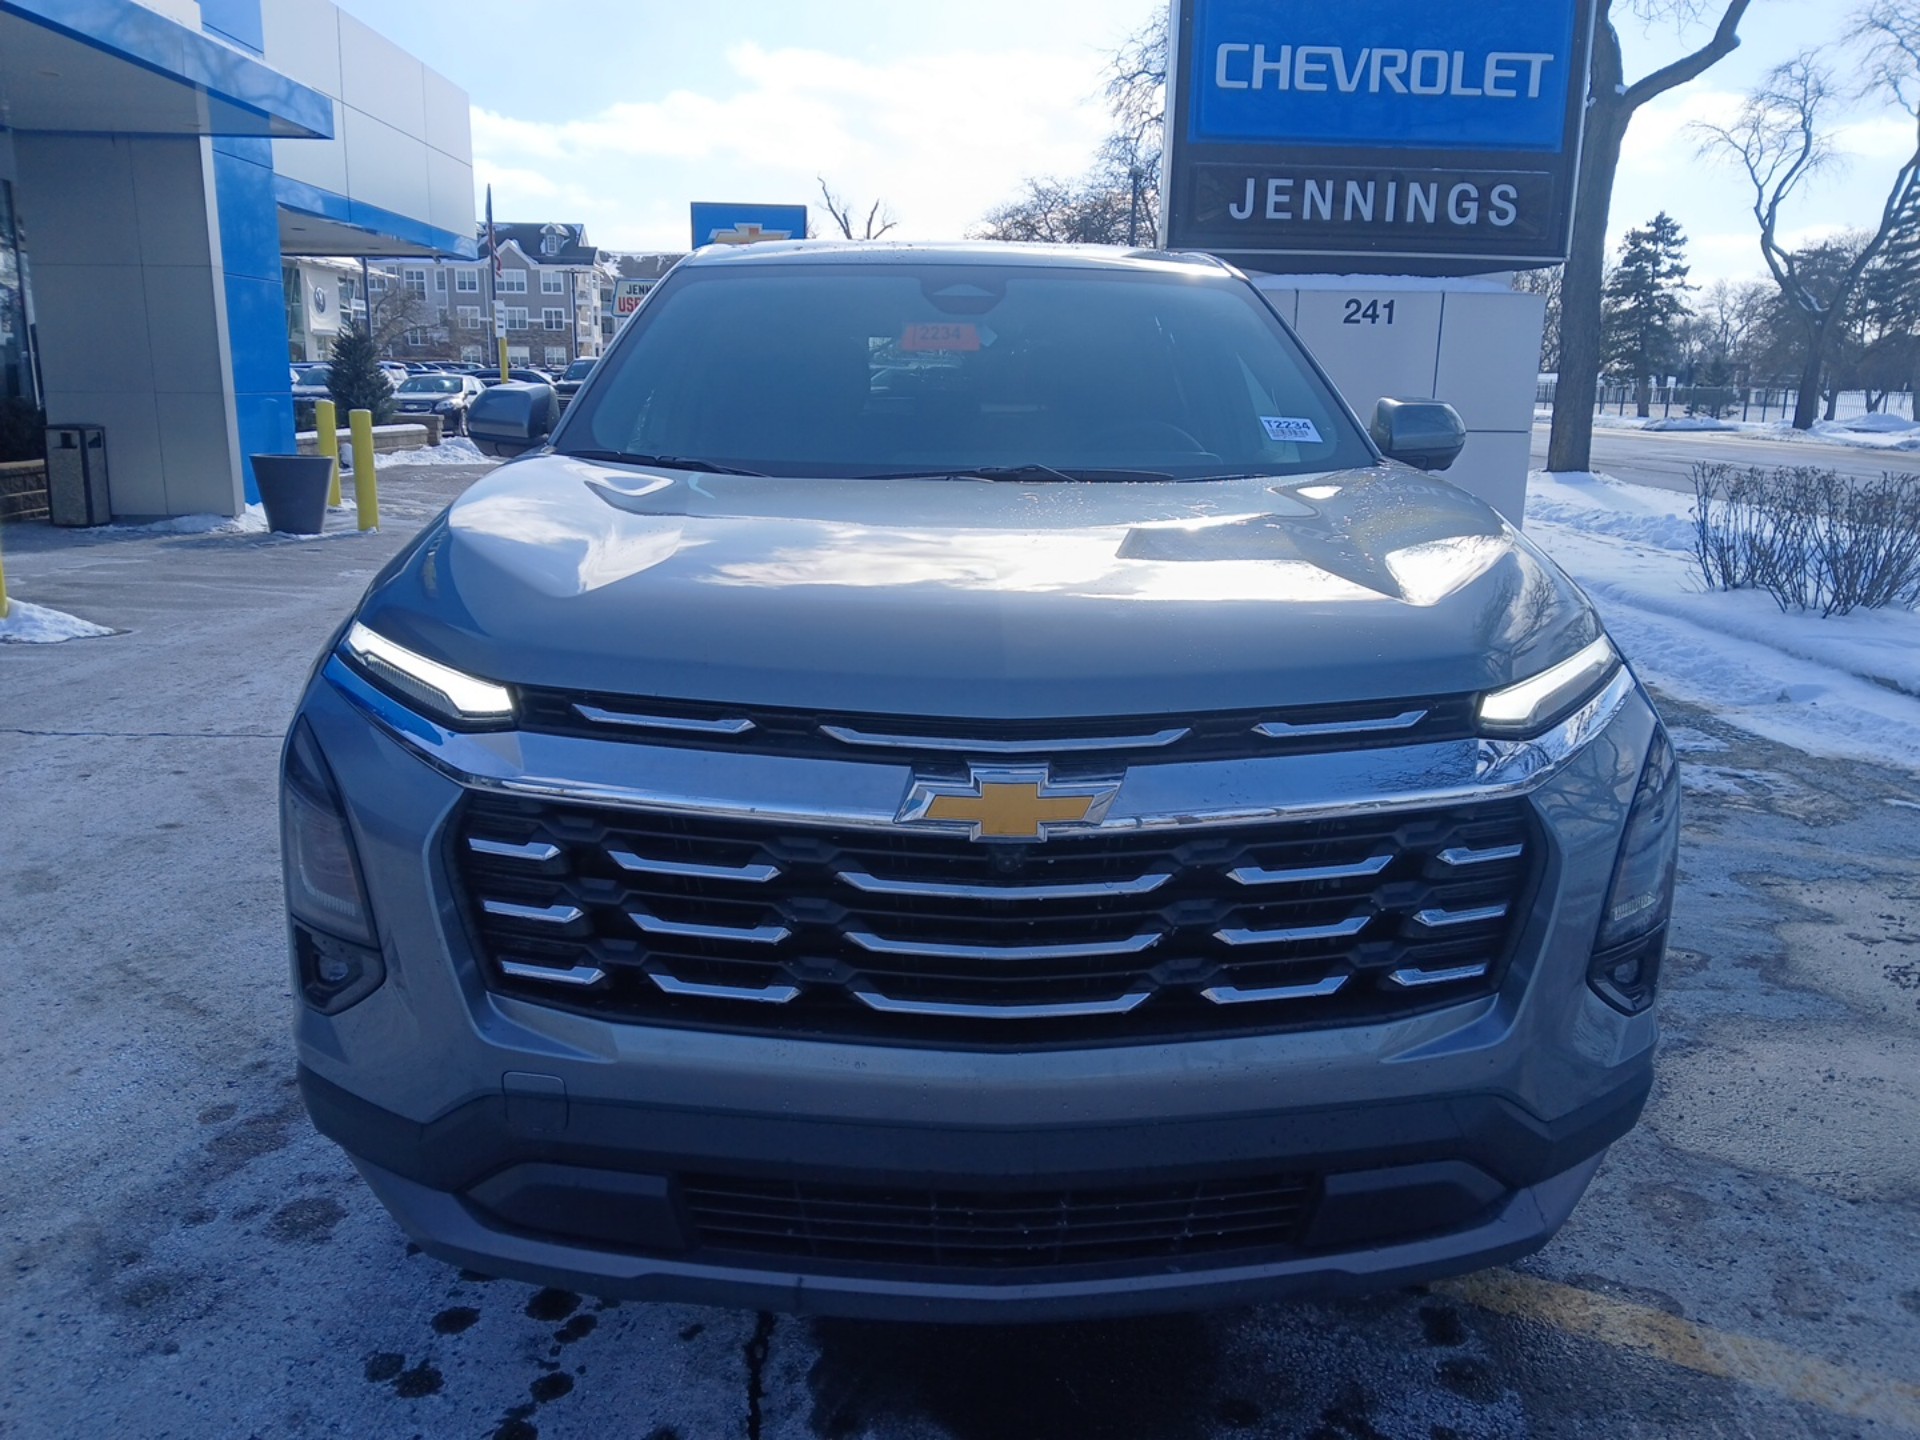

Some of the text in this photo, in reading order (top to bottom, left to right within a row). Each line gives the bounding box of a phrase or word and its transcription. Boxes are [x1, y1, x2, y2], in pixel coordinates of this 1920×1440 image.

[1216, 43, 1554, 98] CHEVROLET
[1228, 177, 1518, 227] JENNINGS
[1342, 298, 1395, 325] 241
[1263, 419, 1311, 430] T2234
